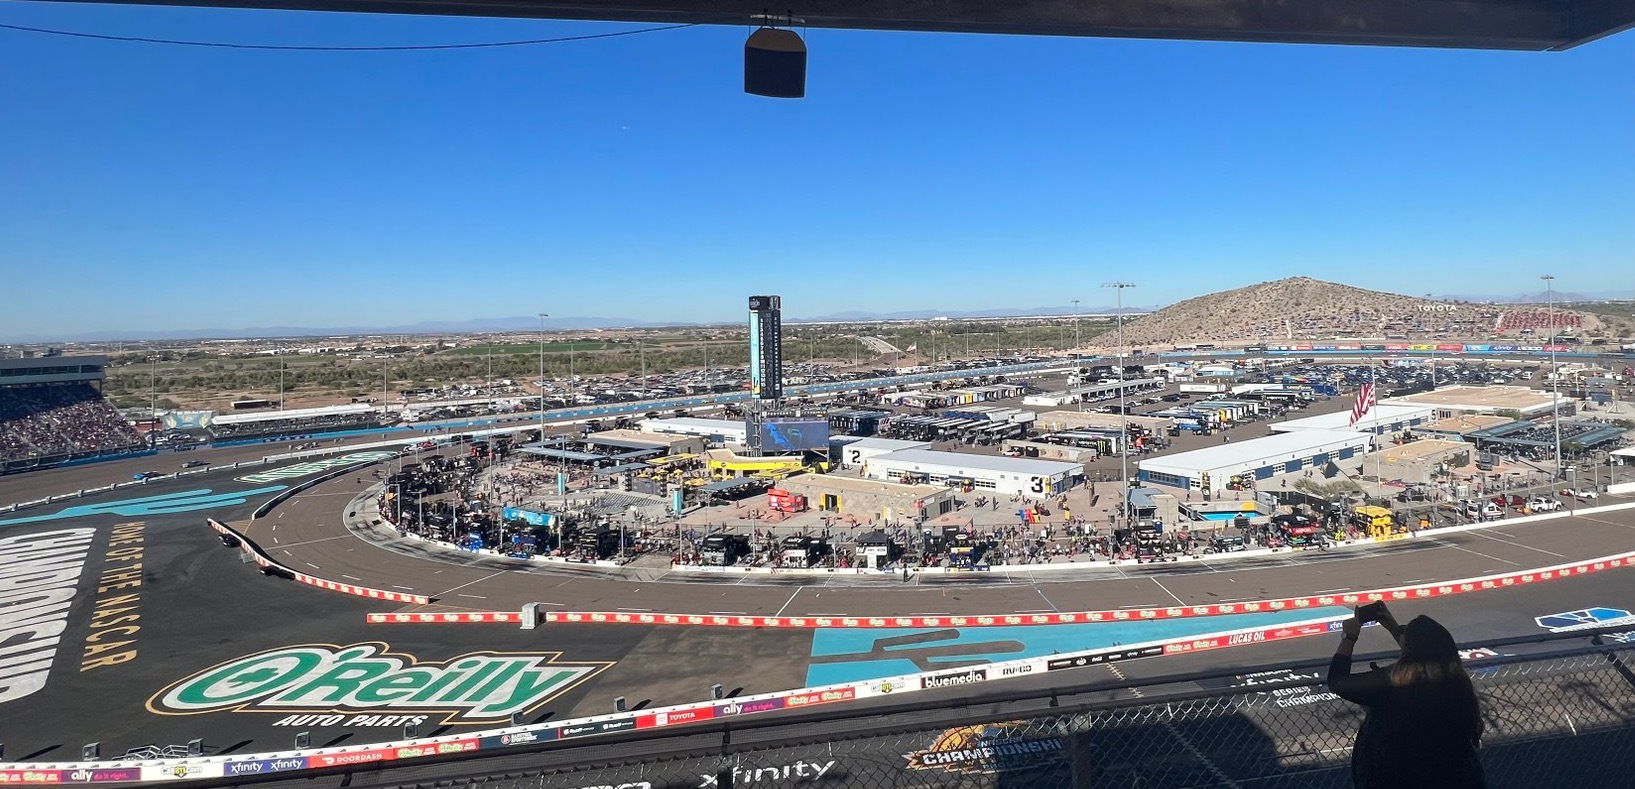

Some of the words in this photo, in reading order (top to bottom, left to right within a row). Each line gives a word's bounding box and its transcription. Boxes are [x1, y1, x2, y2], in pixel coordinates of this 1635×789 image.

[1431, 409, 1436, 420] 5
[852, 450, 861, 463] 2
[1031, 476, 1043, 493] 3
[105, 547, 144, 562] OF
[98, 563, 143, 593] THE
[80, 593, 141, 672] NASCAR
[1228, 632, 1252, 645] LUCAS
[1253, 631, 1265, 642] OIL
[163, 646, 597, 718] O'Reilly
[723, 703, 743, 714] ally
[272, 715, 346, 727] AUTO
[343, 715, 429, 727] PARTS
[669, 712, 695, 720] TOYOTA
[337, 753, 382, 763] DOORDASH
[922, 738, 1065, 766] CHAMPIONSHI
[231, 761, 263, 773] xfinity
[270, 759, 303, 770] xfinity
[71, 769, 93, 782] ally
[698, 760, 836, 787] xfinity
